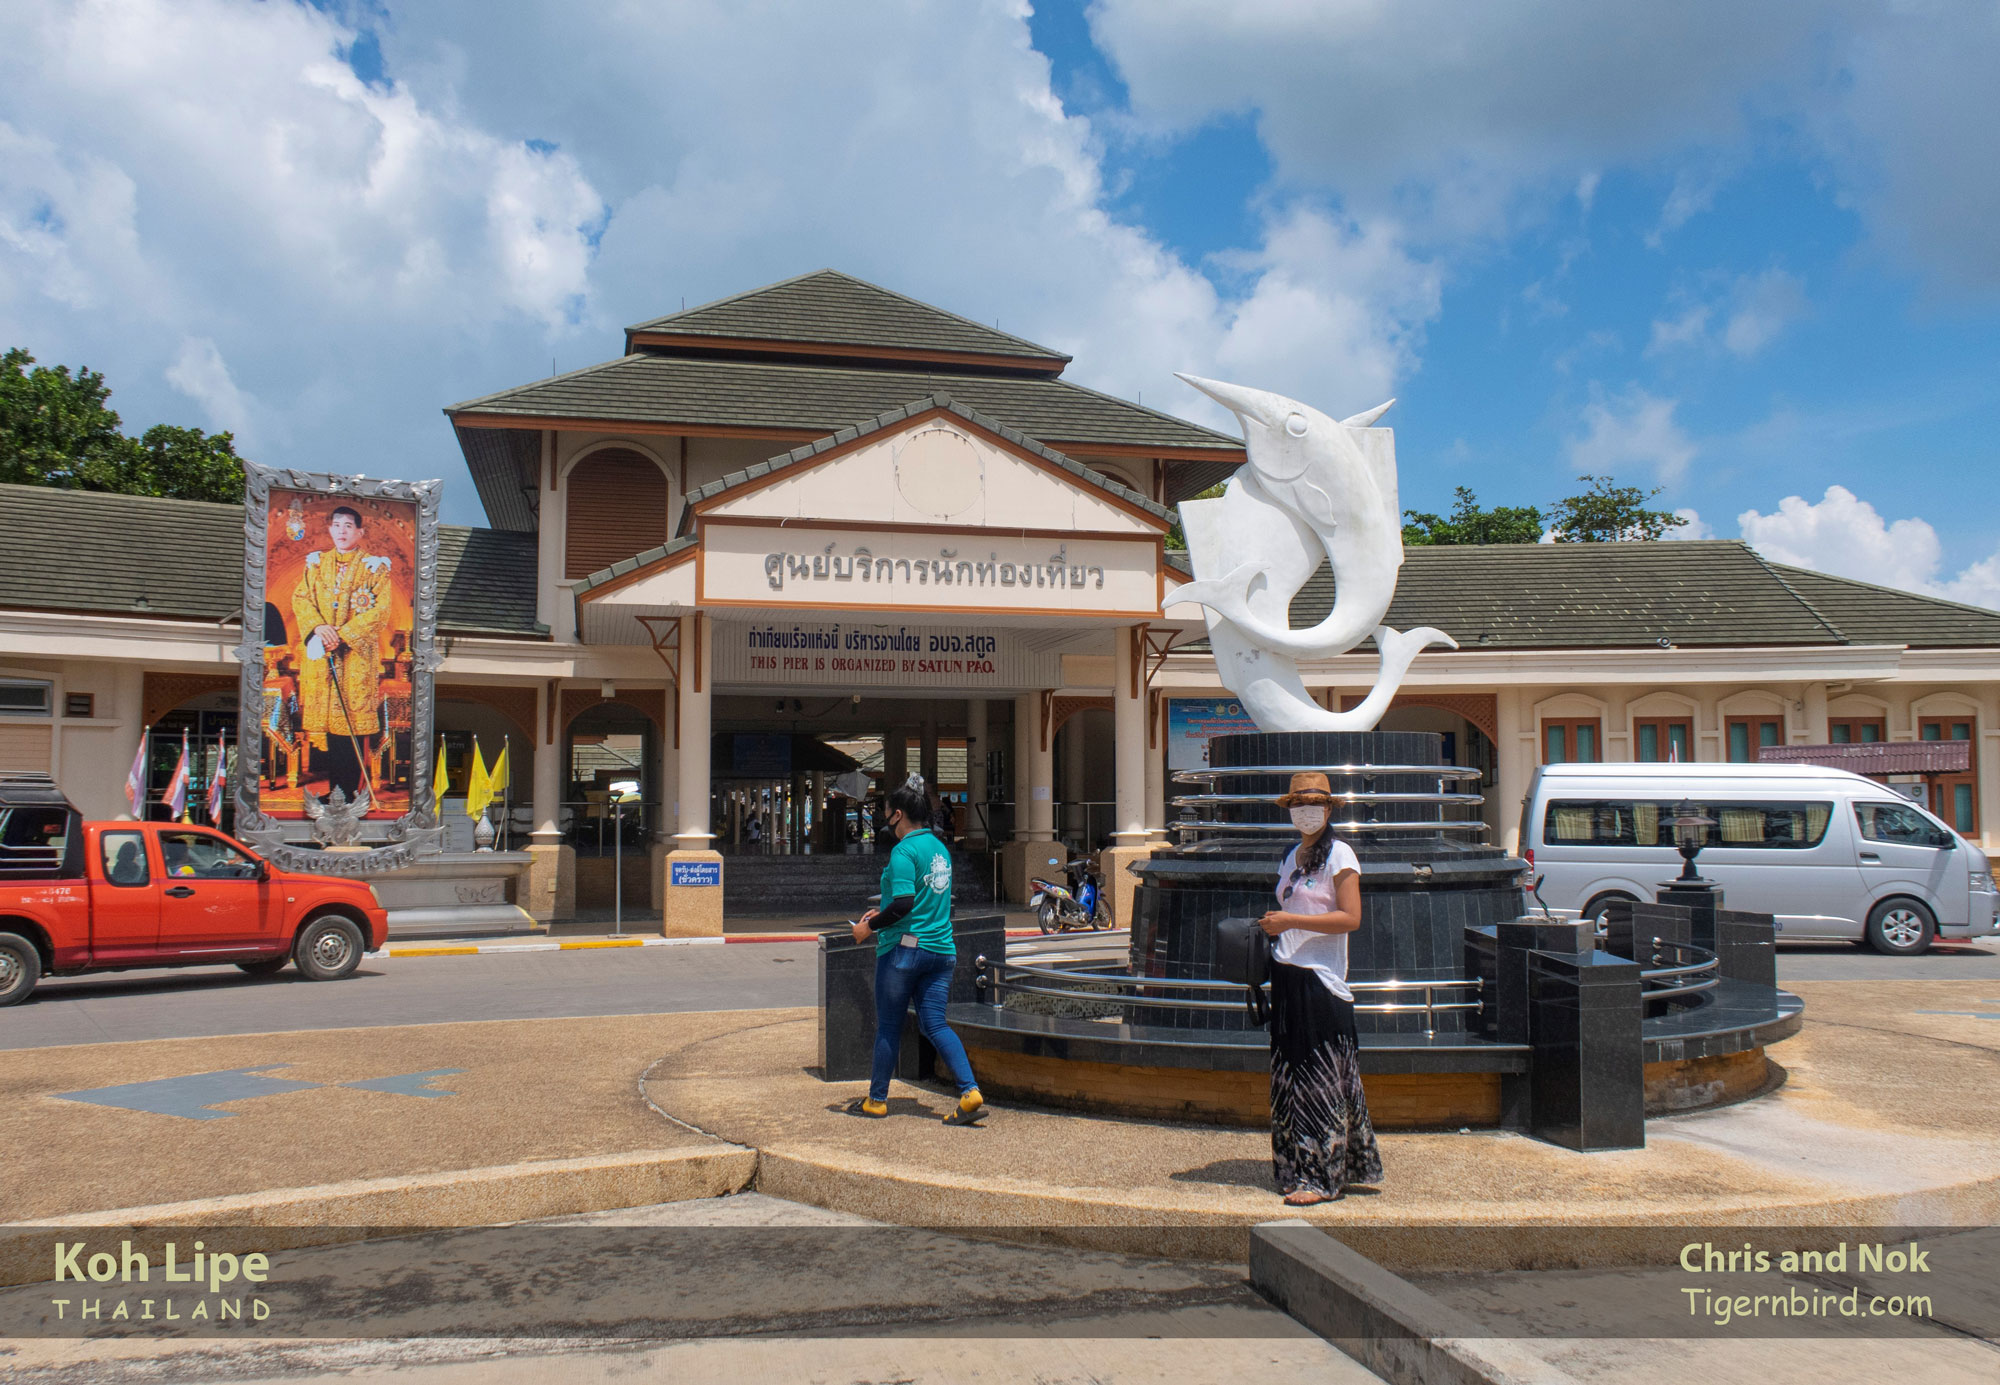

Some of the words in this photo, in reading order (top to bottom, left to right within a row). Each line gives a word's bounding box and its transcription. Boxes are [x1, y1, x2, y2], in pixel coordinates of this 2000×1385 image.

[764, 542, 1105, 591] ศูนย์บริการนักท่องเที่ยว
[749, 624, 840, 650] ท่าเทียบเรือแห่งนี้
[845, 628, 920, 652] บริหารงานโดย
[929, 634, 996, 659] อบจ.สตูล
[751, 656, 777, 669] THIS
[783, 656, 809, 670] PIER
[815, 657, 825, 670] IS
[832, 658, 896, 672] ORGANIZED
[902, 660, 916, 672] BY
[918, 659, 963, 673] SATUN
[966, 660, 995, 674] PAO.
